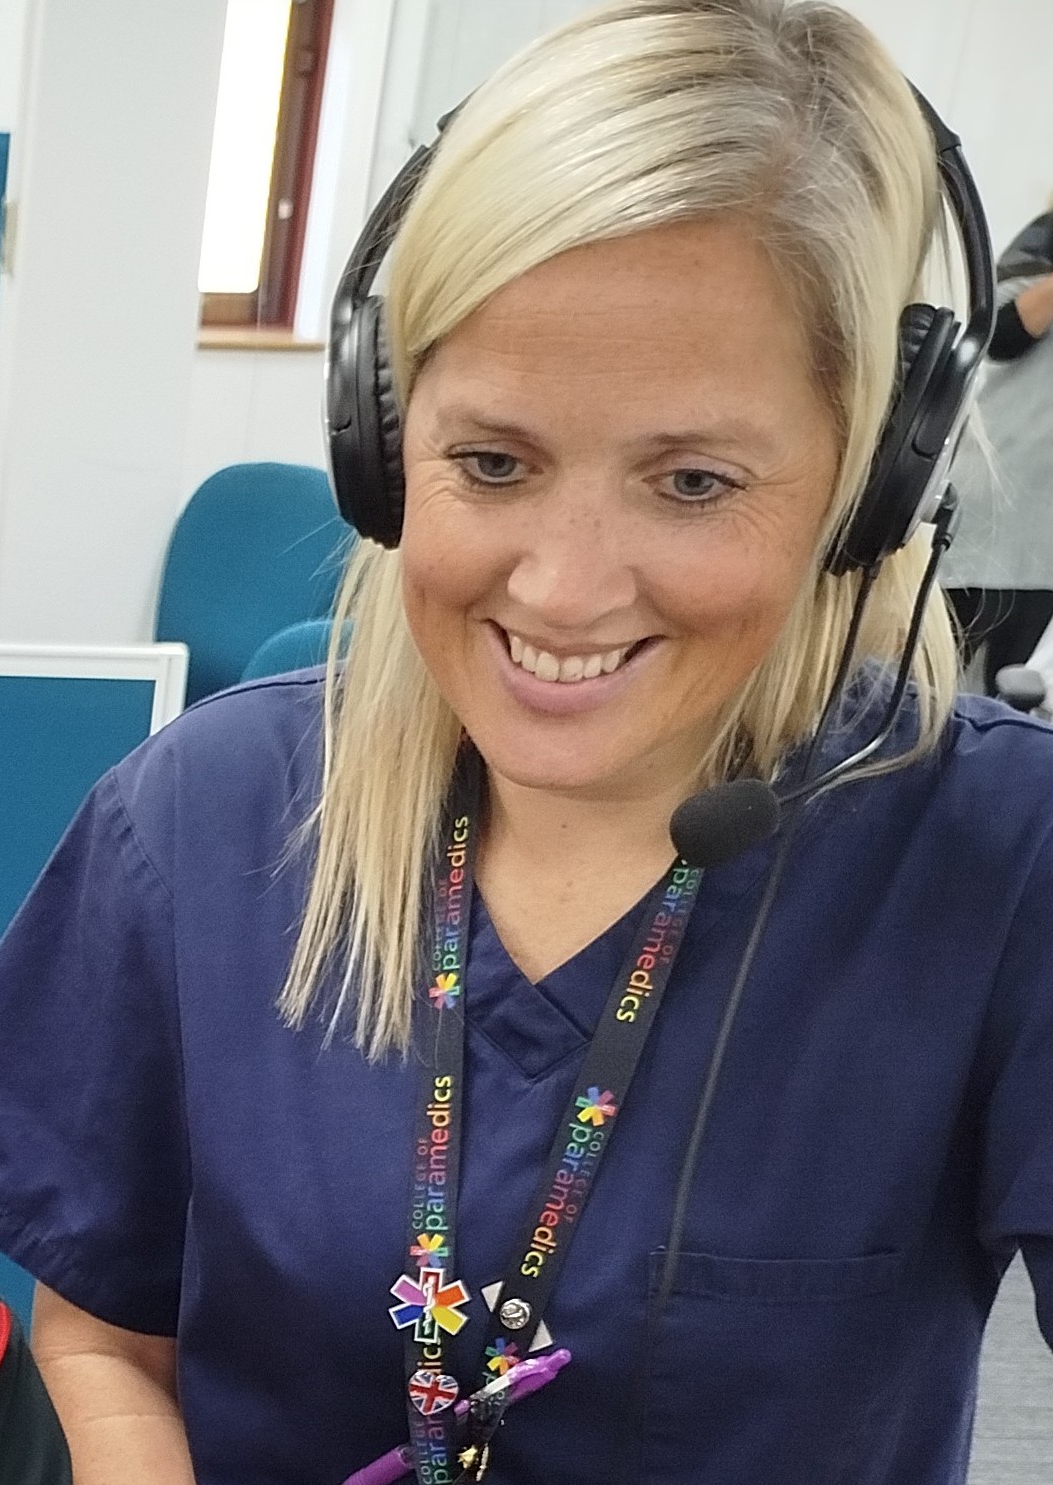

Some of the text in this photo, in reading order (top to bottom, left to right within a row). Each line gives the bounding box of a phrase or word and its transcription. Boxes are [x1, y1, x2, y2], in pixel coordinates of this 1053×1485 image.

[442, 815, 470, 970] paramedics
[616, 868, 690, 1024] paramedics
[412, 1137, 429, 1230] COLLEGE OF
[425, 1075, 453, 1231] paramedics
[520, 1123, 594, 1279] paramedics
